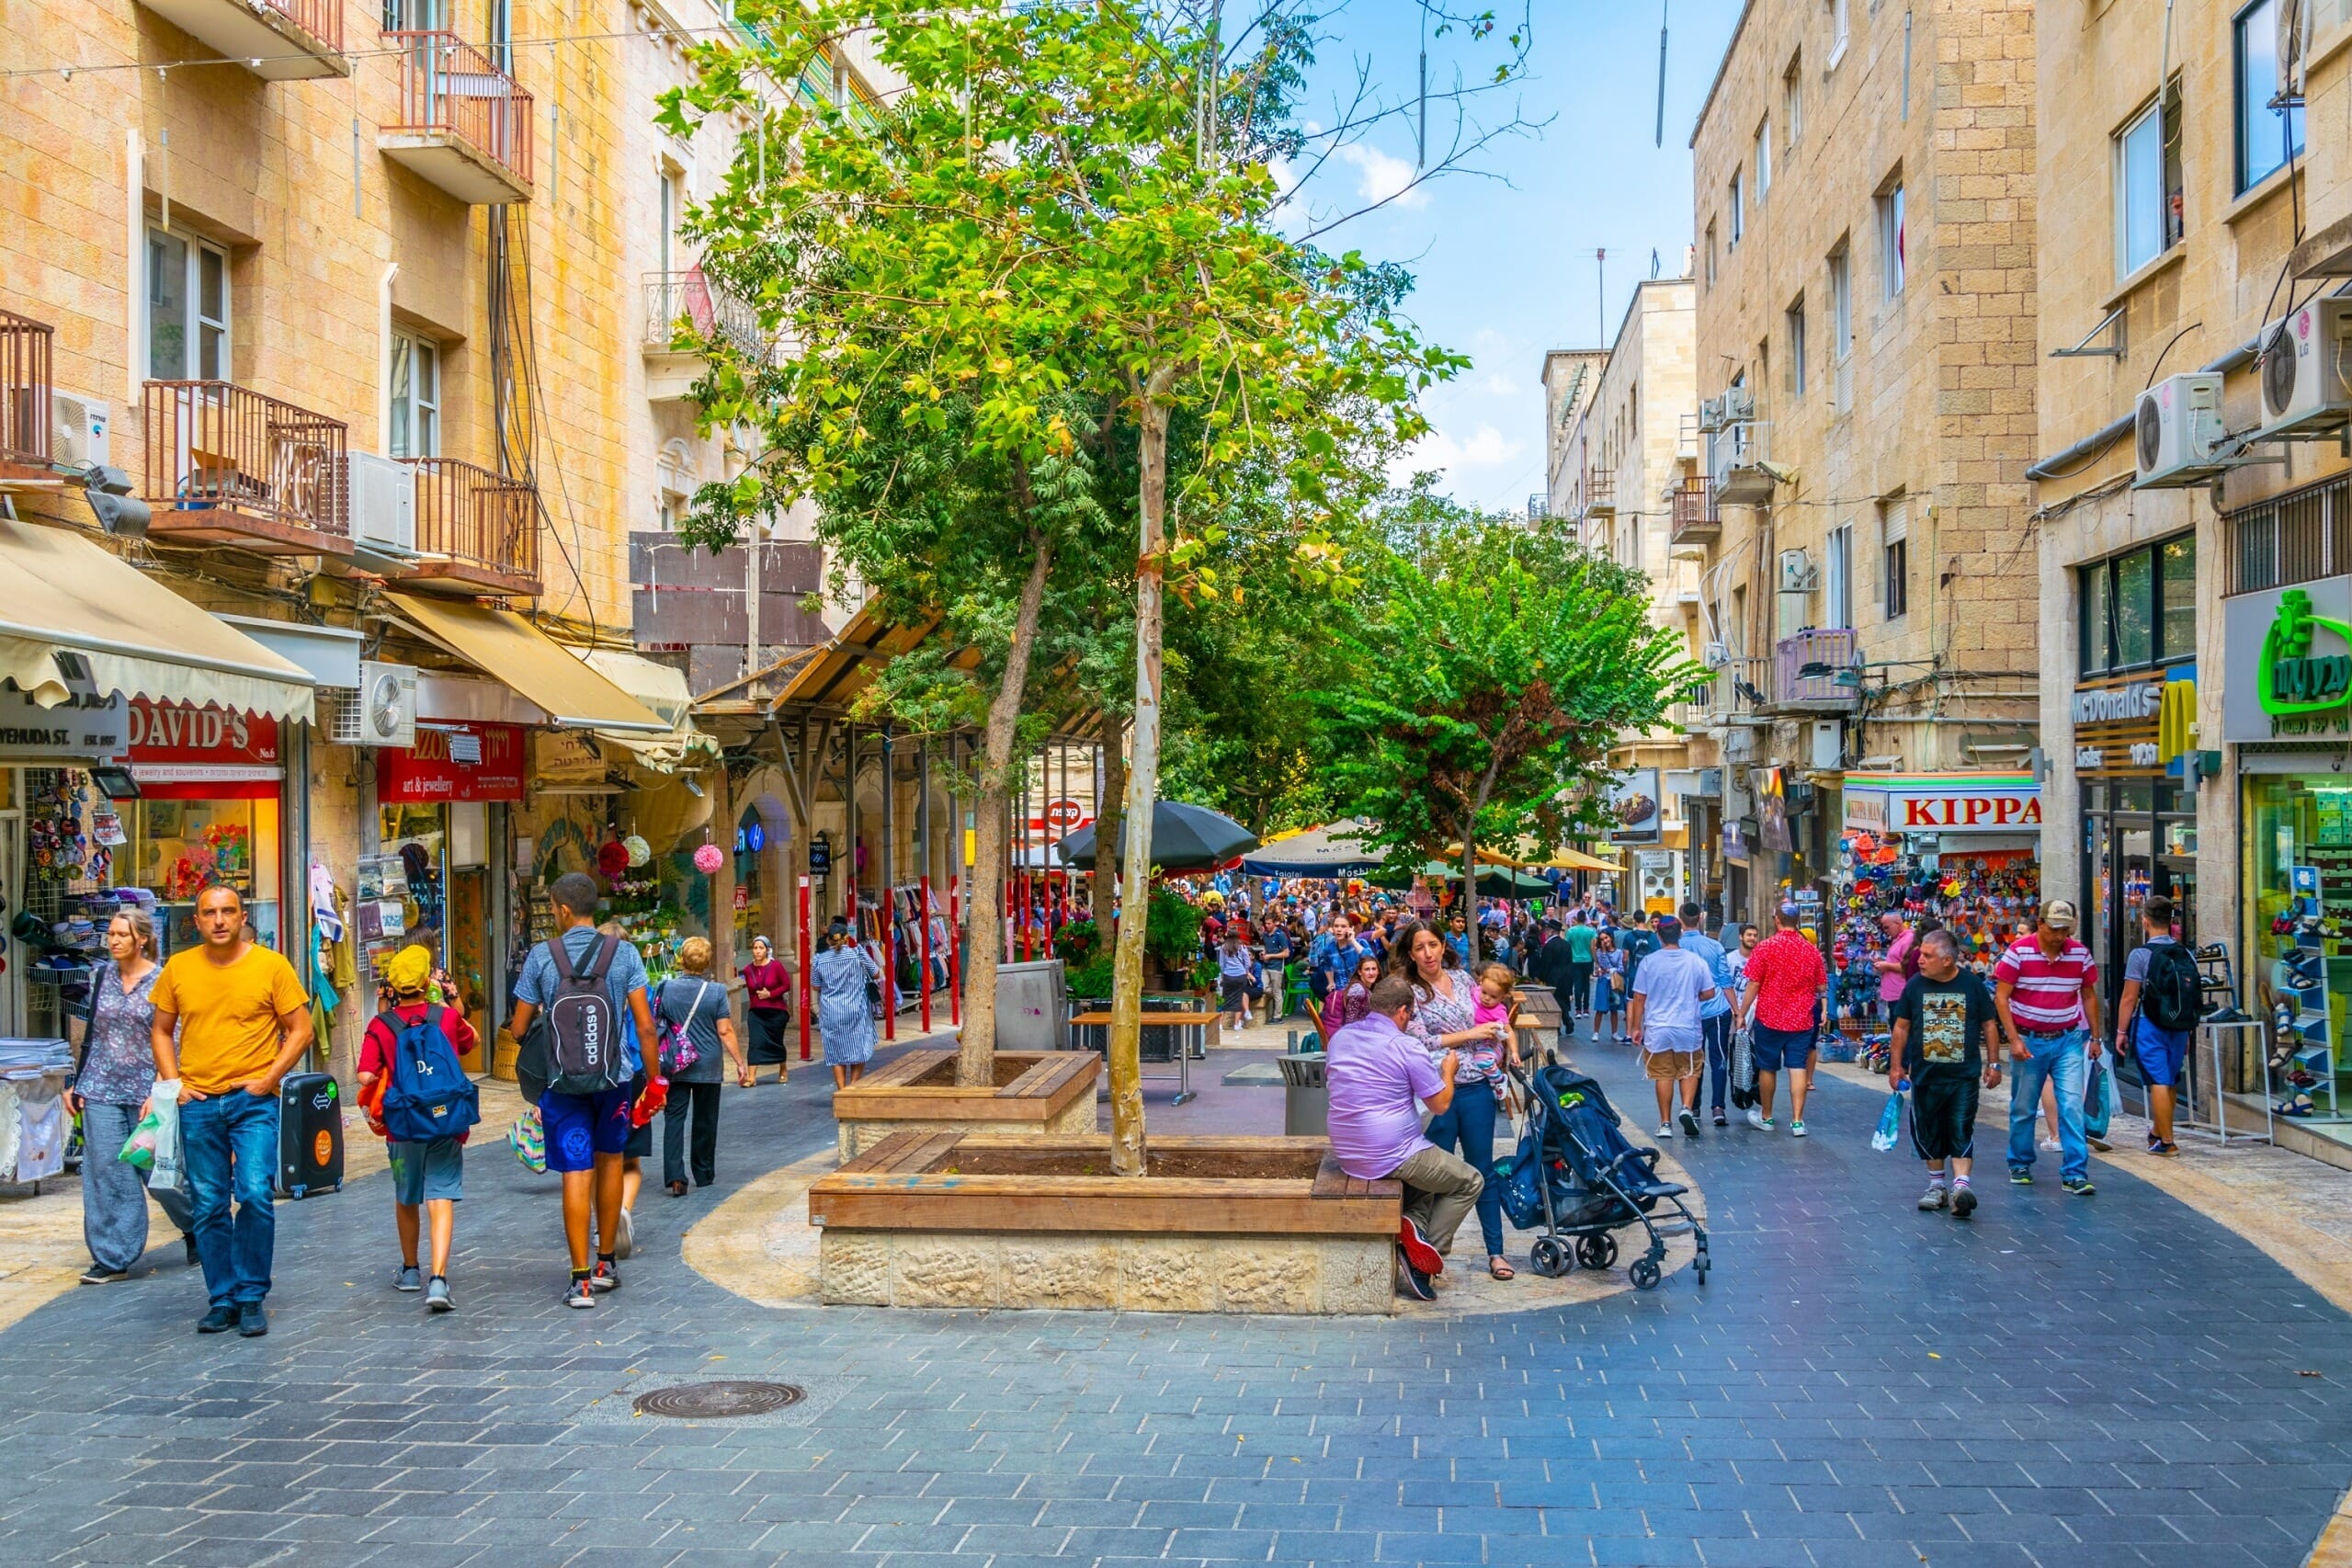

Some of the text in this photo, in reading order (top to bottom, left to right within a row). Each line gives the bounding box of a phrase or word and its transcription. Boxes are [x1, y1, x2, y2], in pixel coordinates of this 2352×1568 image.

[2300, 343, 2309, 358] LG
[2072, 684, 2158, 723] McDonald's
[52, 729, 71, 745] ST.
[129, 706, 249, 749] DAVID'S
[403, 780, 415, 793] art
[1850, 800, 1867, 820] KIPPA
[1903, 797, 2041, 826] KIPPA
[1927, 1017, 1960, 1026] adidas
[585, 1014, 598, 1065] adidas
